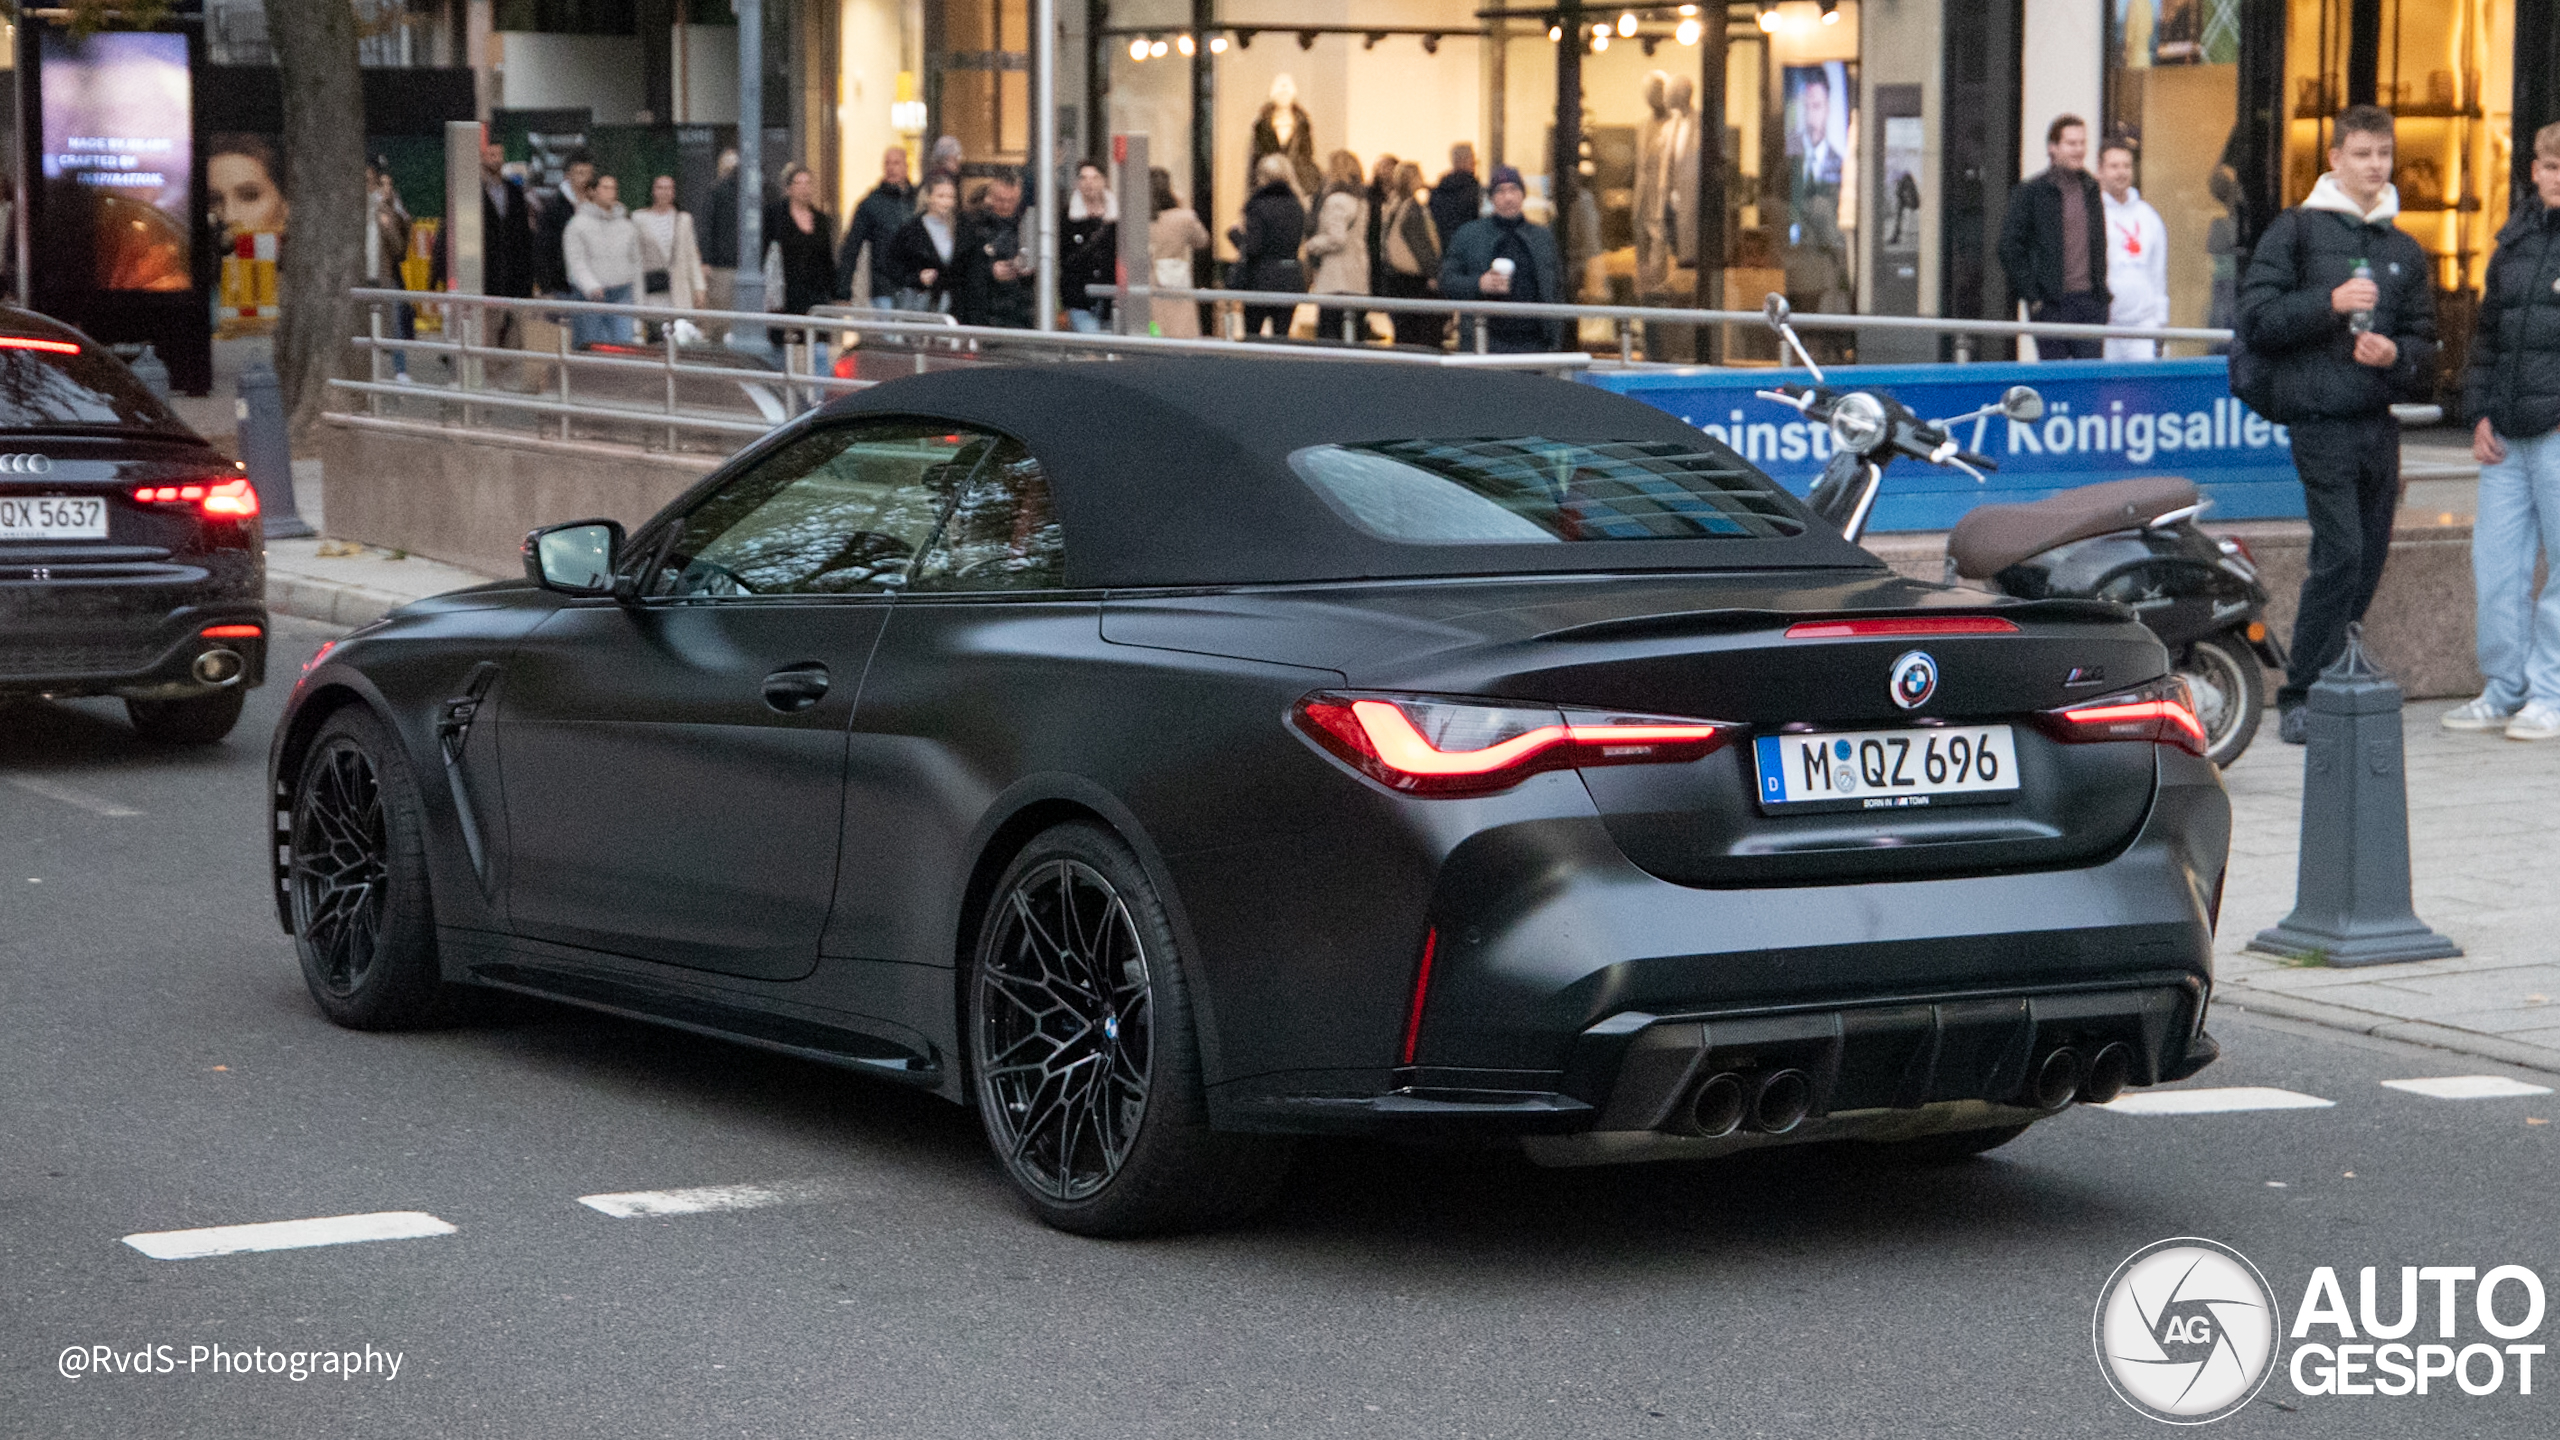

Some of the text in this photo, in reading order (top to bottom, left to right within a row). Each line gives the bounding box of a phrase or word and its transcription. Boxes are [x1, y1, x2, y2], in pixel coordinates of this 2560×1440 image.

[68, 136, 107, 149] MADE
[58, 154, 118, 168] CRAFTED
[1, 500, 100, 527] QX 5637
[1768, 734, 1999, 792] D M QZ 696
[1863, 798, 1884, 808] BORN
[1885, 798, 1893, 807] IN
[1909, 796, 1930, 806] TOWN
